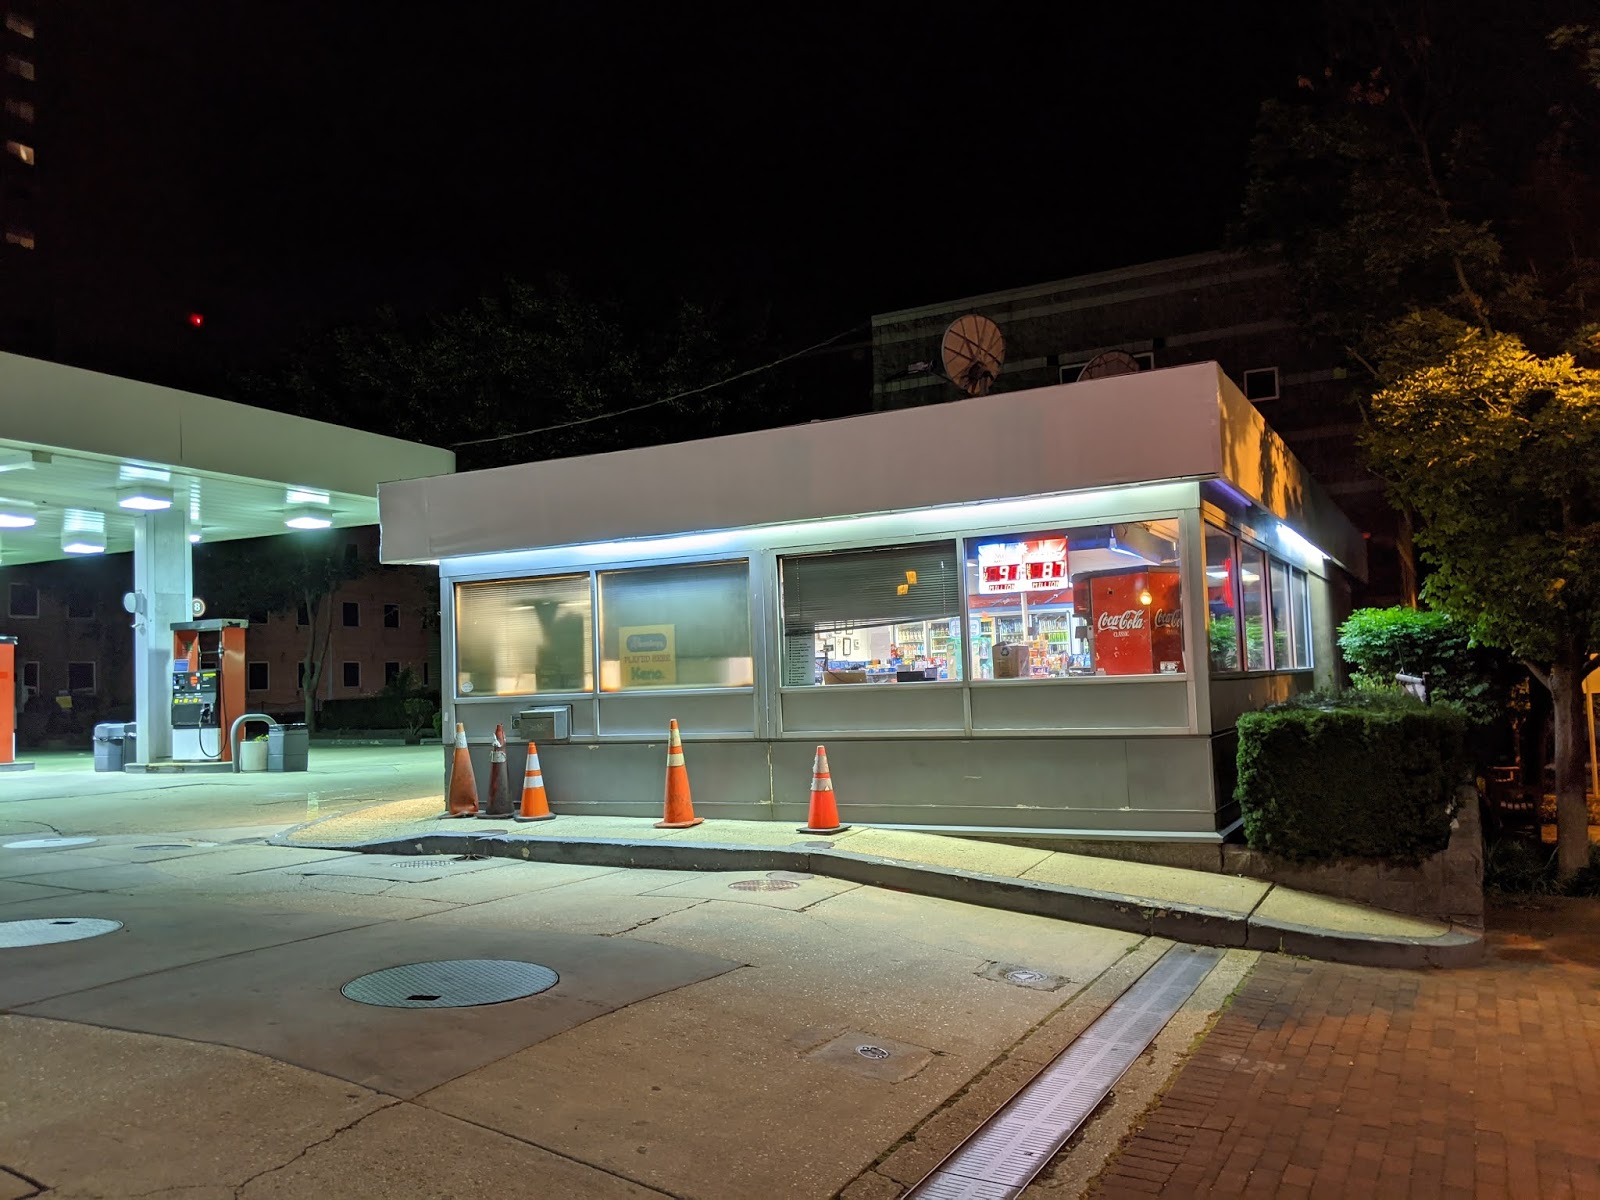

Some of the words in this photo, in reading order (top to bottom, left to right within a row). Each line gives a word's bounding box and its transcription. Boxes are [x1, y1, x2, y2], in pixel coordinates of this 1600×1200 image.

[999, 564, 1020, 580] 91
[1042, 560, 1065, 578] 87
[194, 602, 201, 611] 8
[1098, 609, 1145, 631] Coca-Cola
